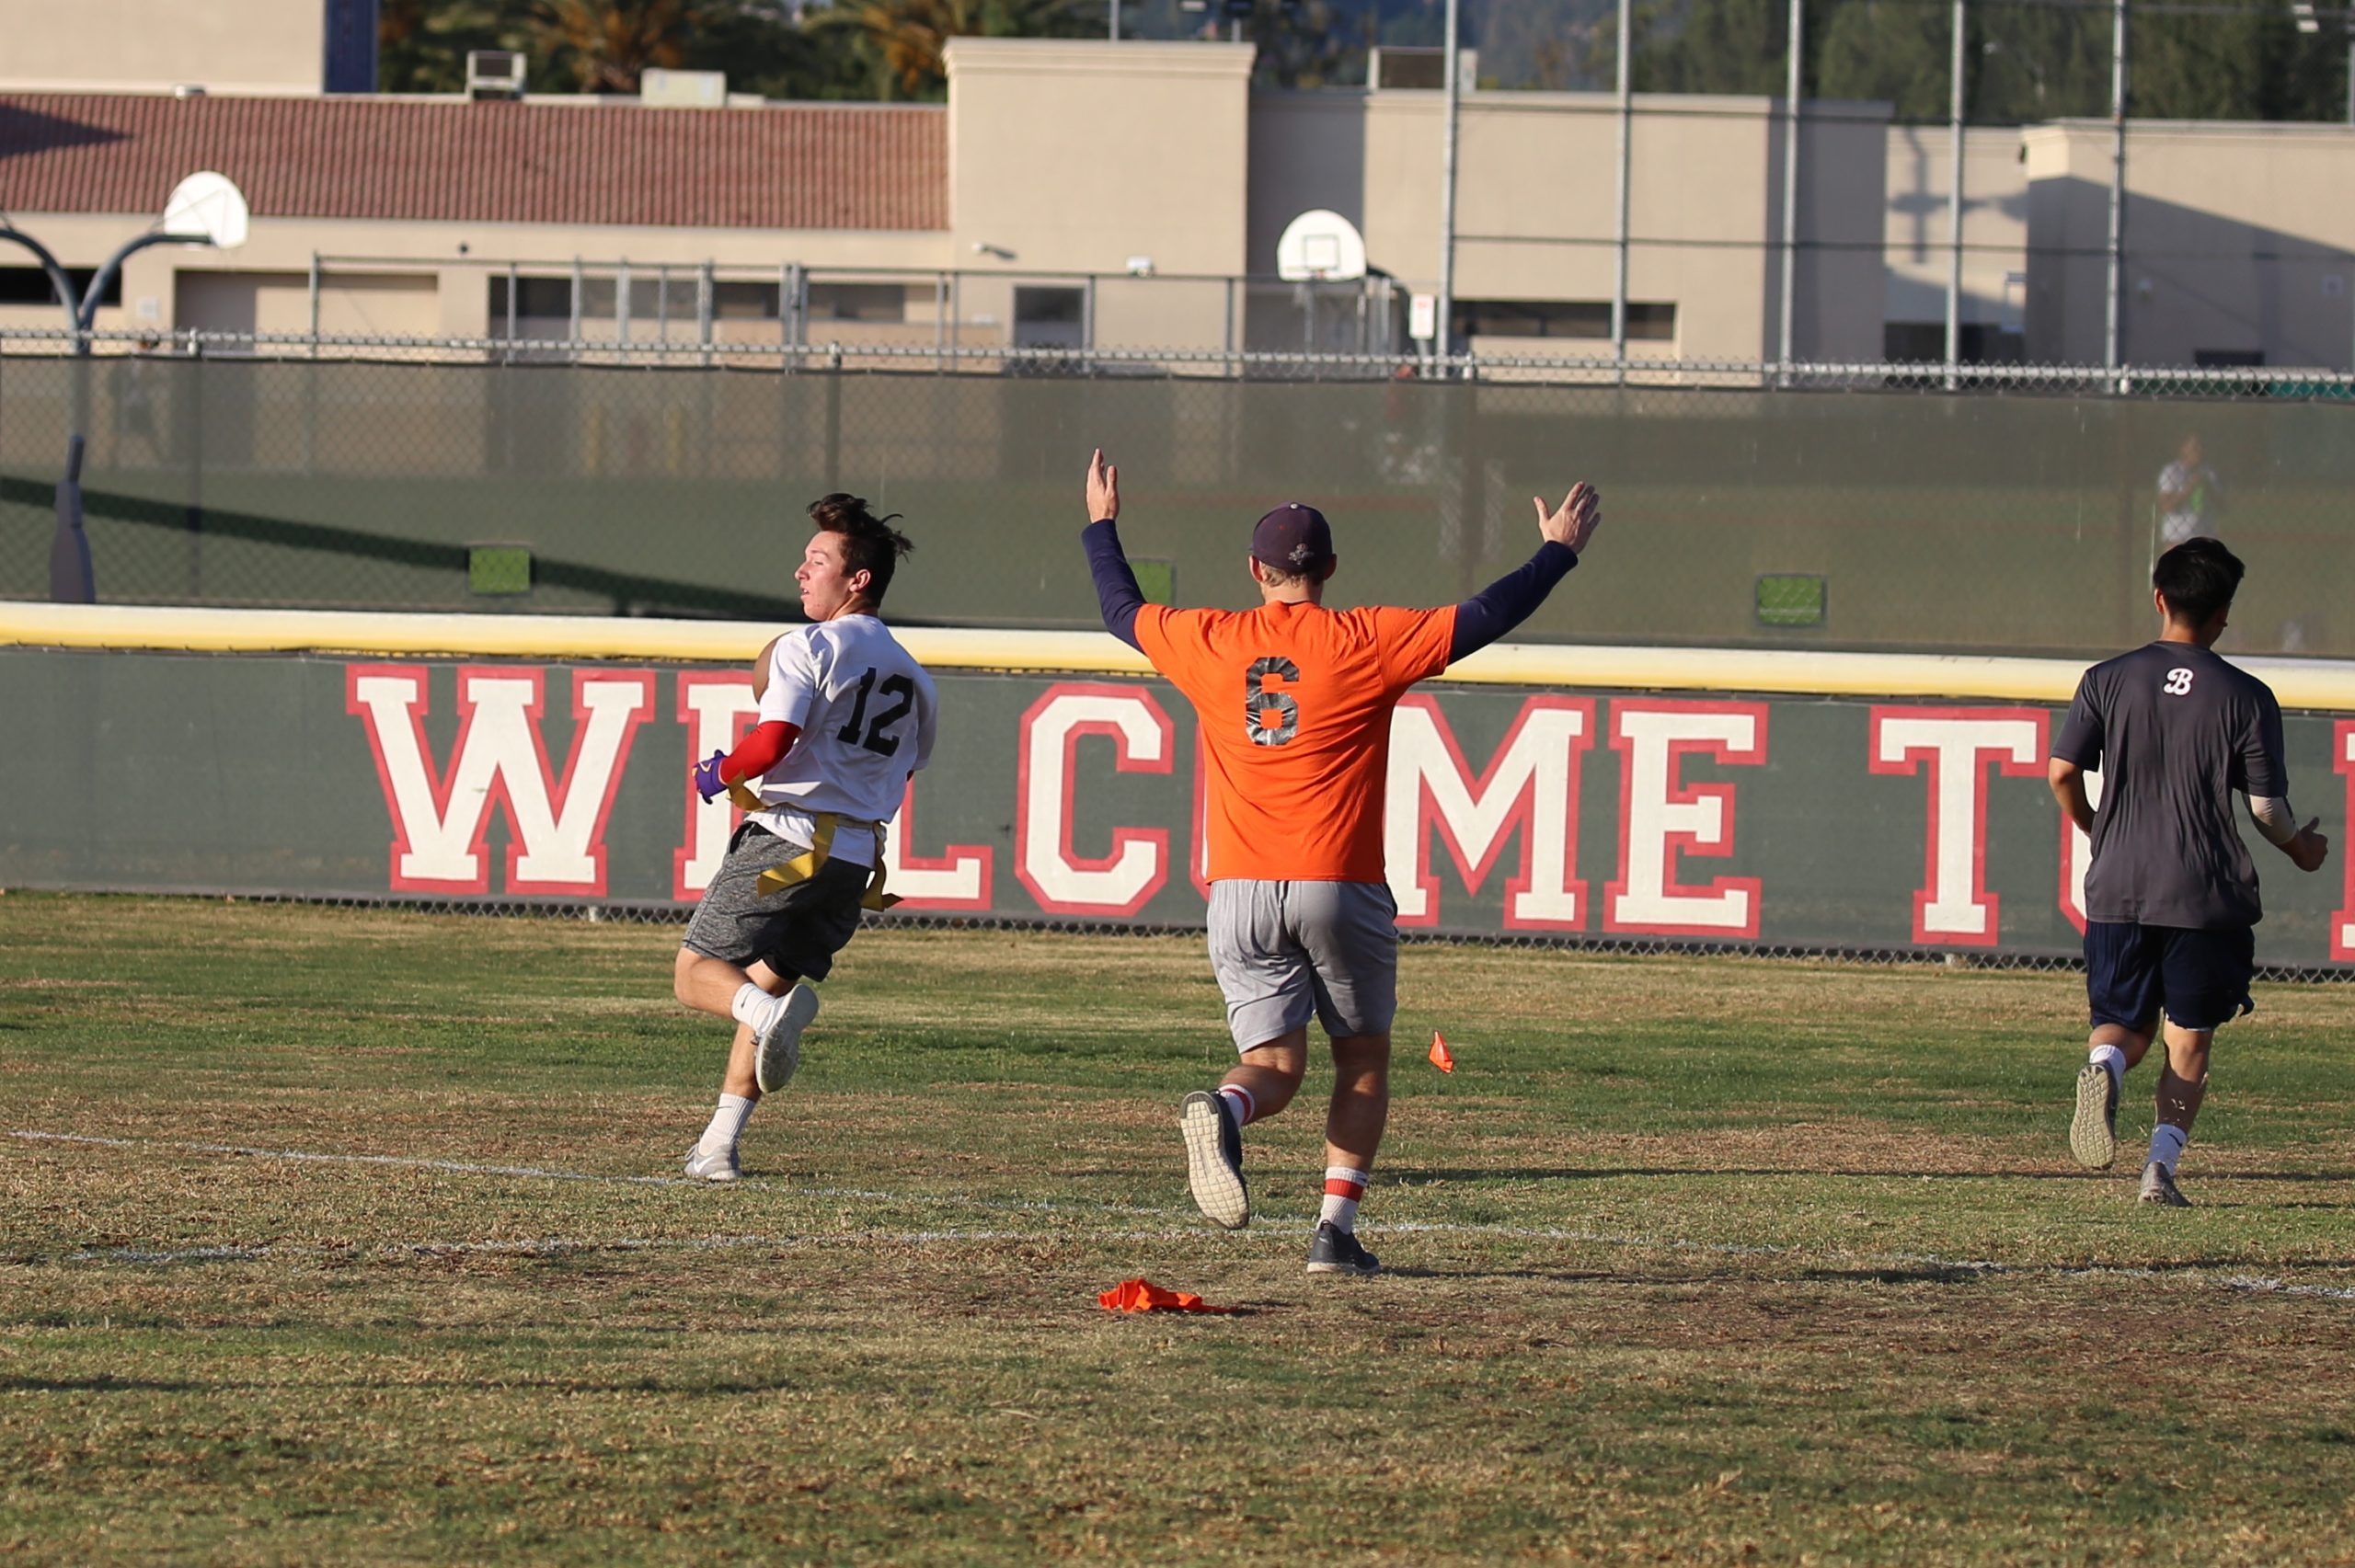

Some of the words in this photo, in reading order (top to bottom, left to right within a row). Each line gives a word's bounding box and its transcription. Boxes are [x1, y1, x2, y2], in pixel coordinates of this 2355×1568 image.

[837, 667, 915, 758] 12
[1245, 656, 1301, 747] 6
[2163, 667, 2194, 696] B
[1868, 704, 2105, 946] T
